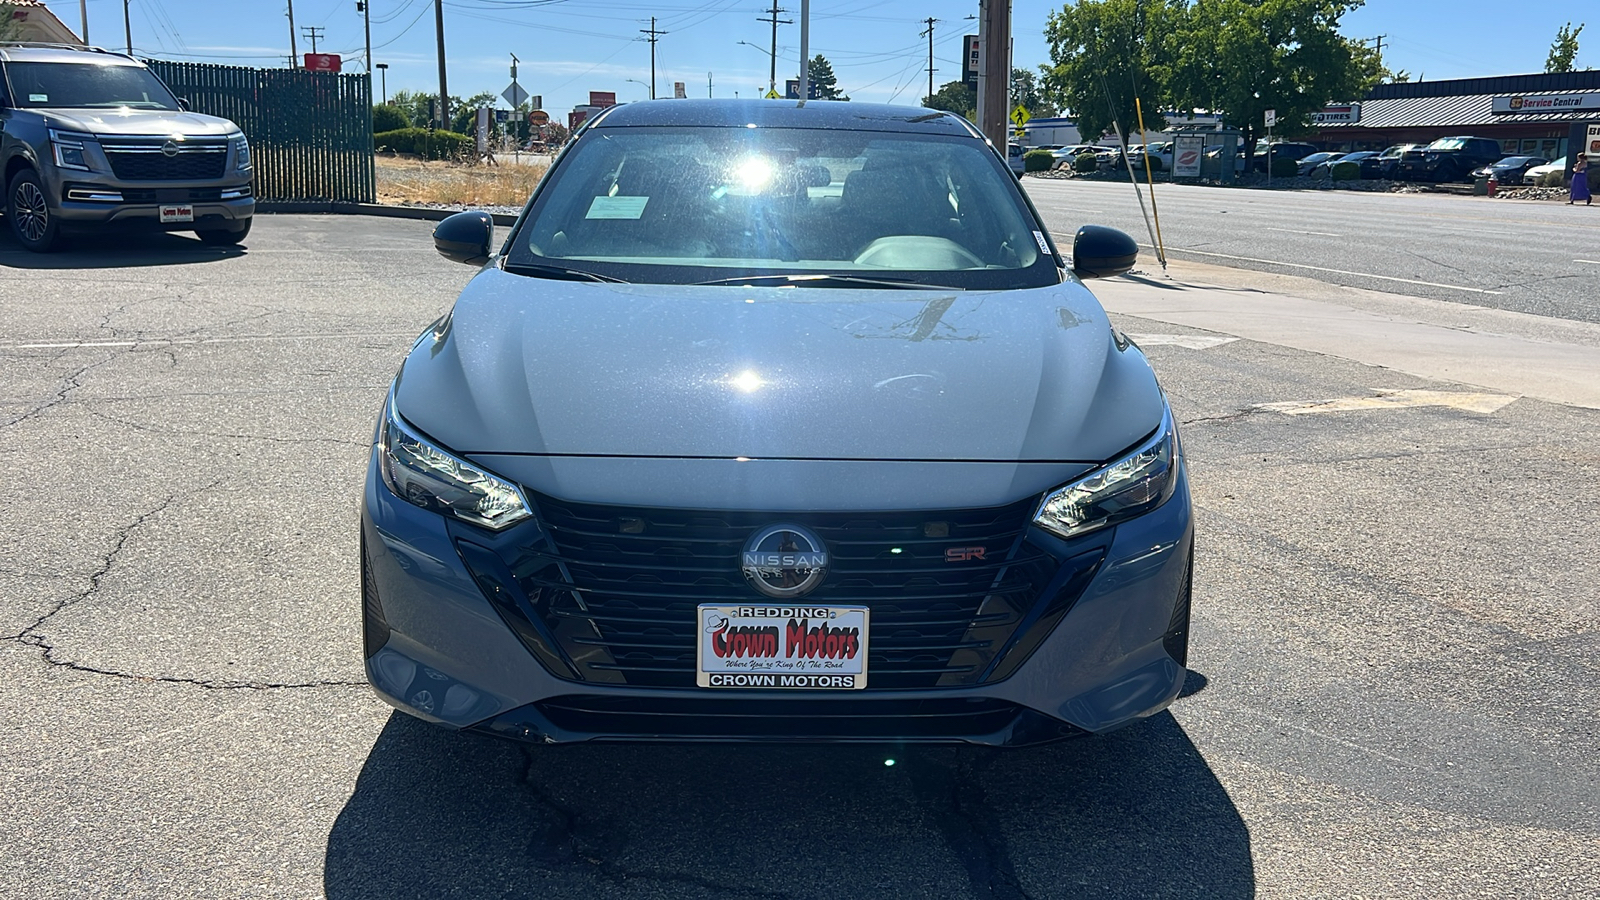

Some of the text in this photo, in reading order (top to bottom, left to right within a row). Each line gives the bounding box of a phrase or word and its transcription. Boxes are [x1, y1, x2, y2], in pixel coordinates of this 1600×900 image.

[1523, 97, 1582, 108] Service Central
[745, 554, 825, 566] NISSAN
[945, 546, 986, 562] SR
[740, 607, 828, 618] REDDING
[712, 618, 860, 660] Crown Motors
[725, 660, 844, 671] Where You're King Of The Road
[710, 675, 854, 687] CROWN MOTORS
